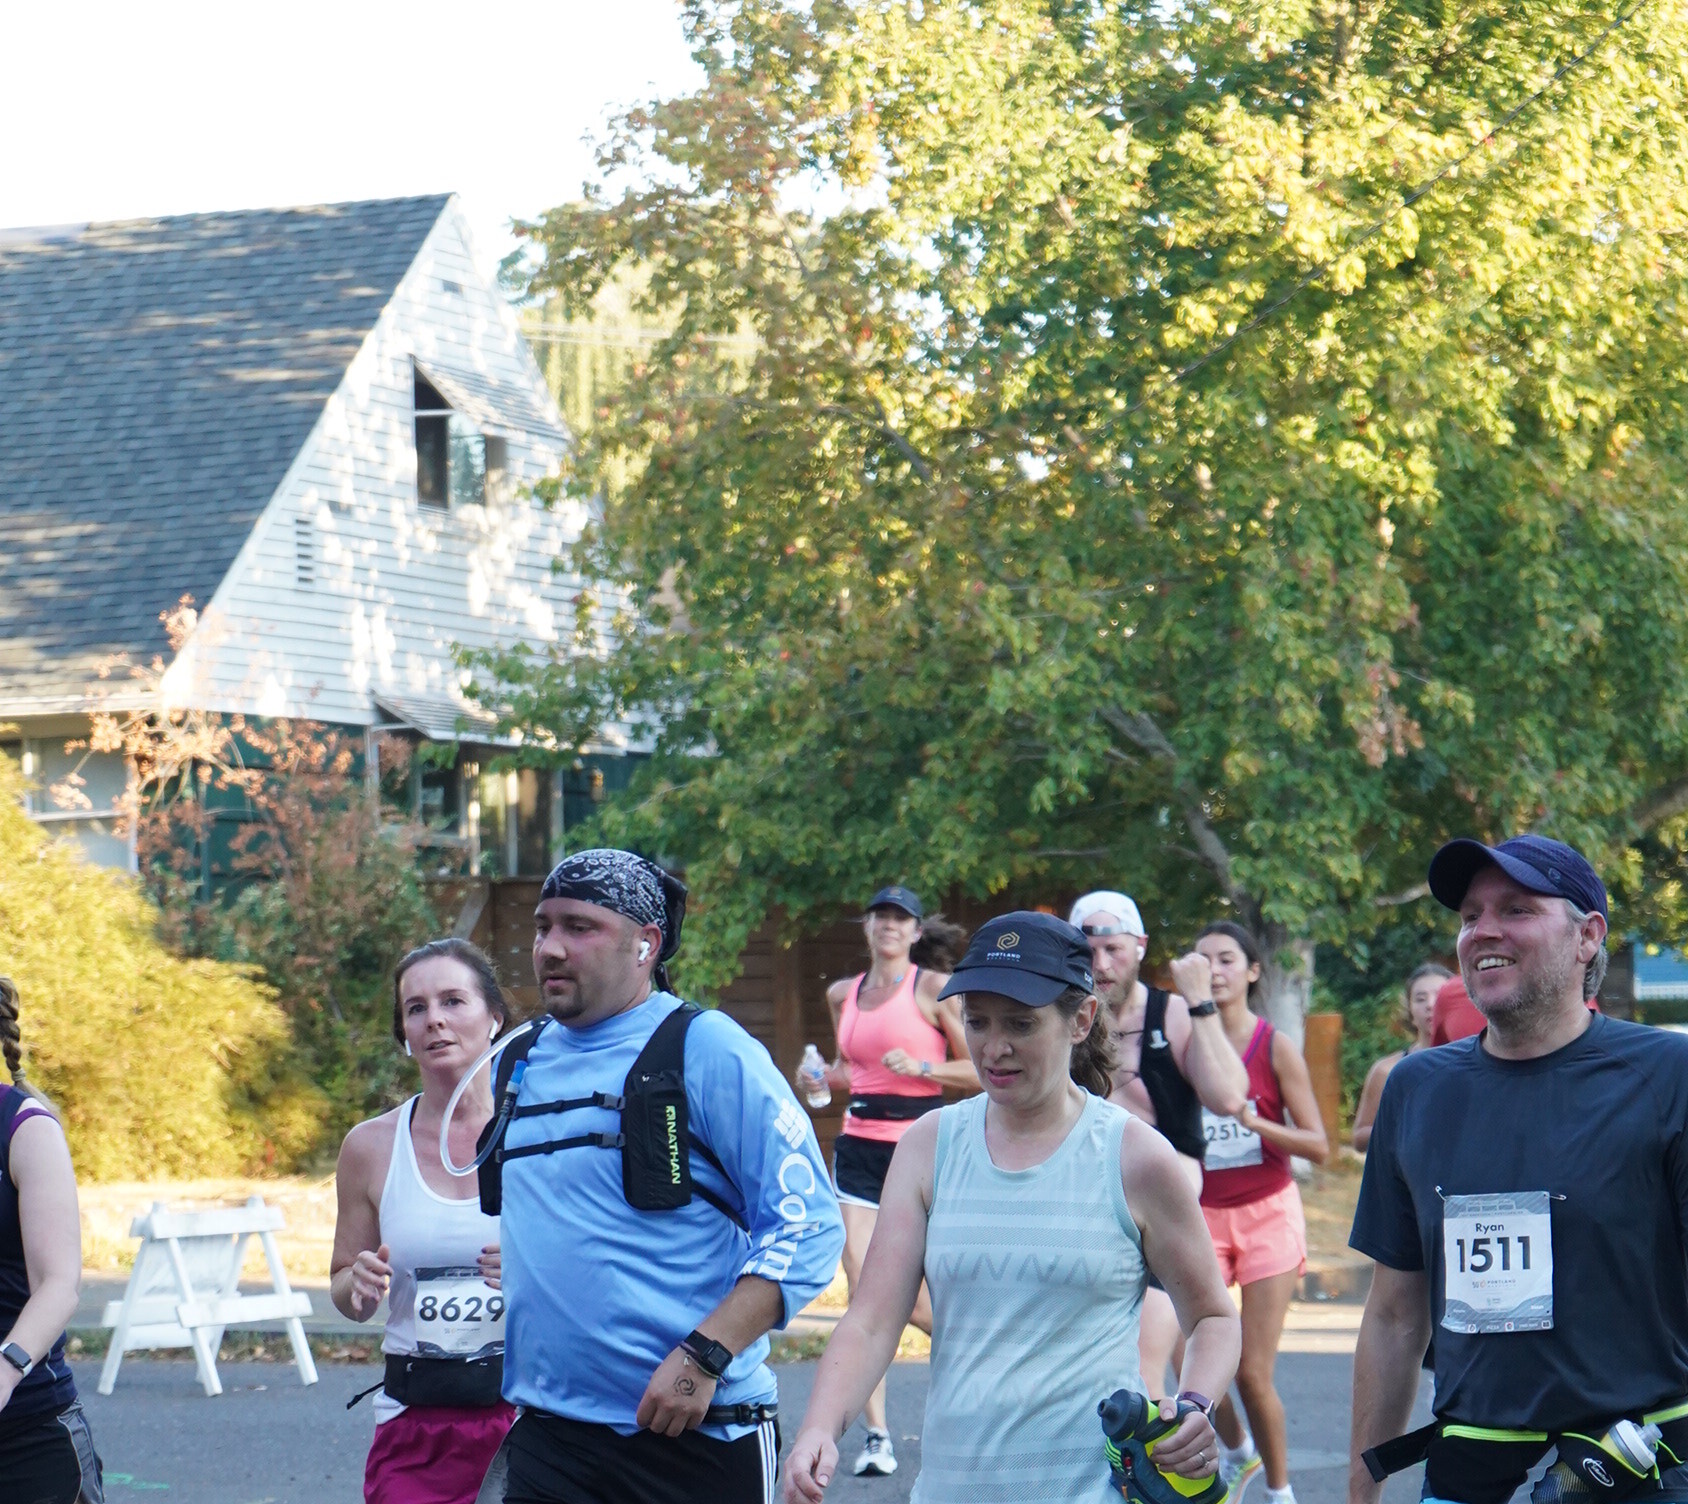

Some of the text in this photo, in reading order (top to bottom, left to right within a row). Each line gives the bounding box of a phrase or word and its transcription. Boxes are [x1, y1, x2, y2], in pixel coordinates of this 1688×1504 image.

[666, 1121, 682, 1185] NATHAN
[1475, 1222, 1505, 1234] Ryan
[1456, 1235, 1531, 1273] 1511
[419, 1295, 506, 1322] 8629
